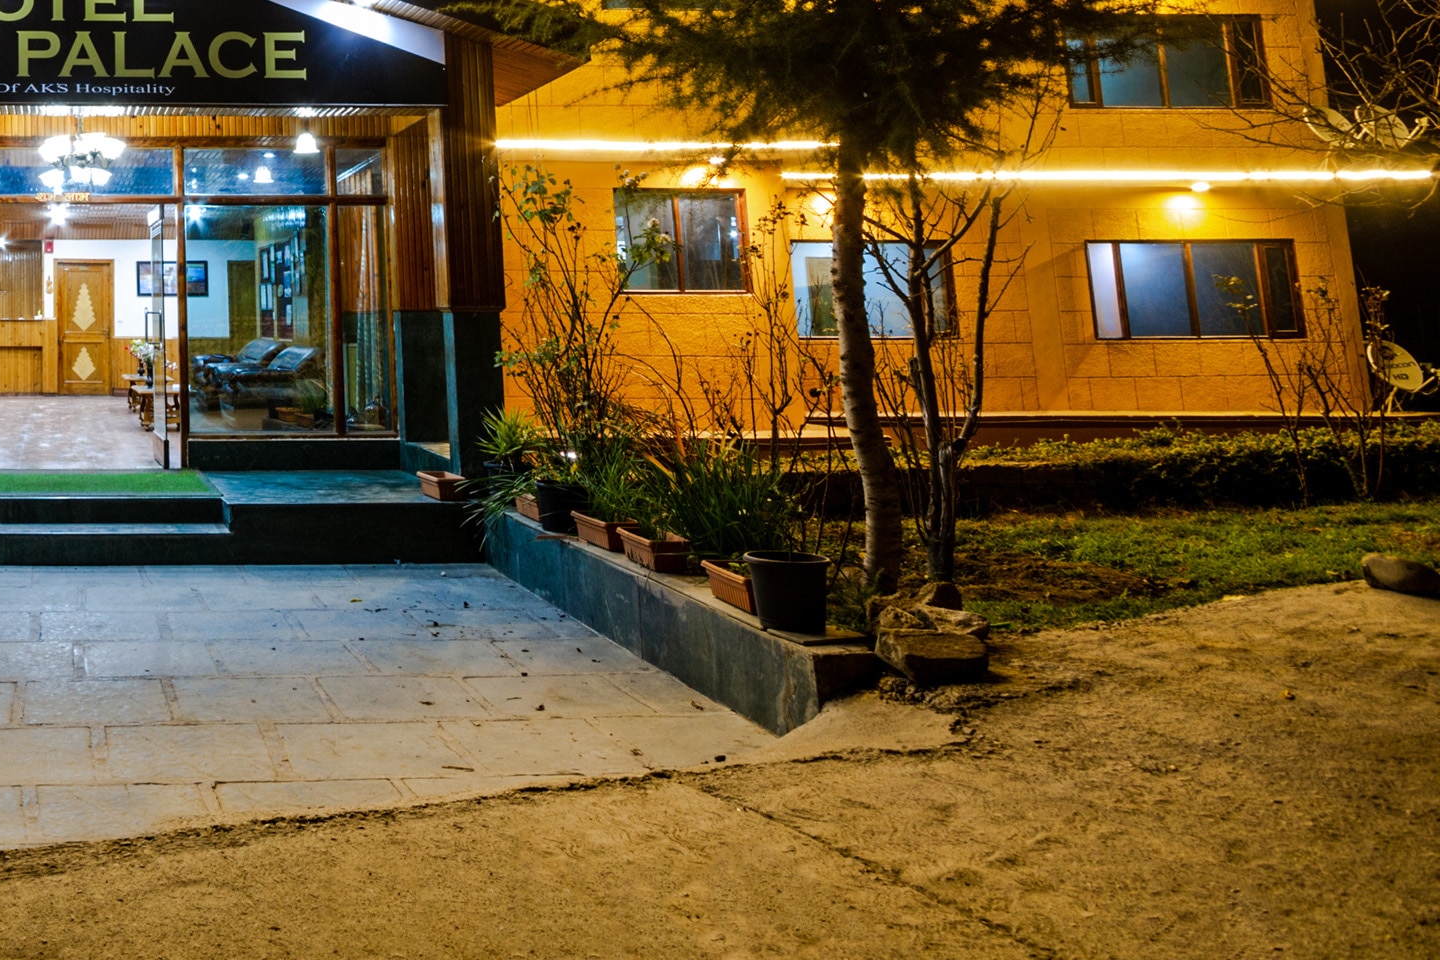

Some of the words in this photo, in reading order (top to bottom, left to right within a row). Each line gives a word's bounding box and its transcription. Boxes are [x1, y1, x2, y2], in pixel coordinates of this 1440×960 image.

[16, 29, 307, 80] PALACE
[24, 82, 69, 94] AKS
[76, 83, 176, 96] Hospitality
